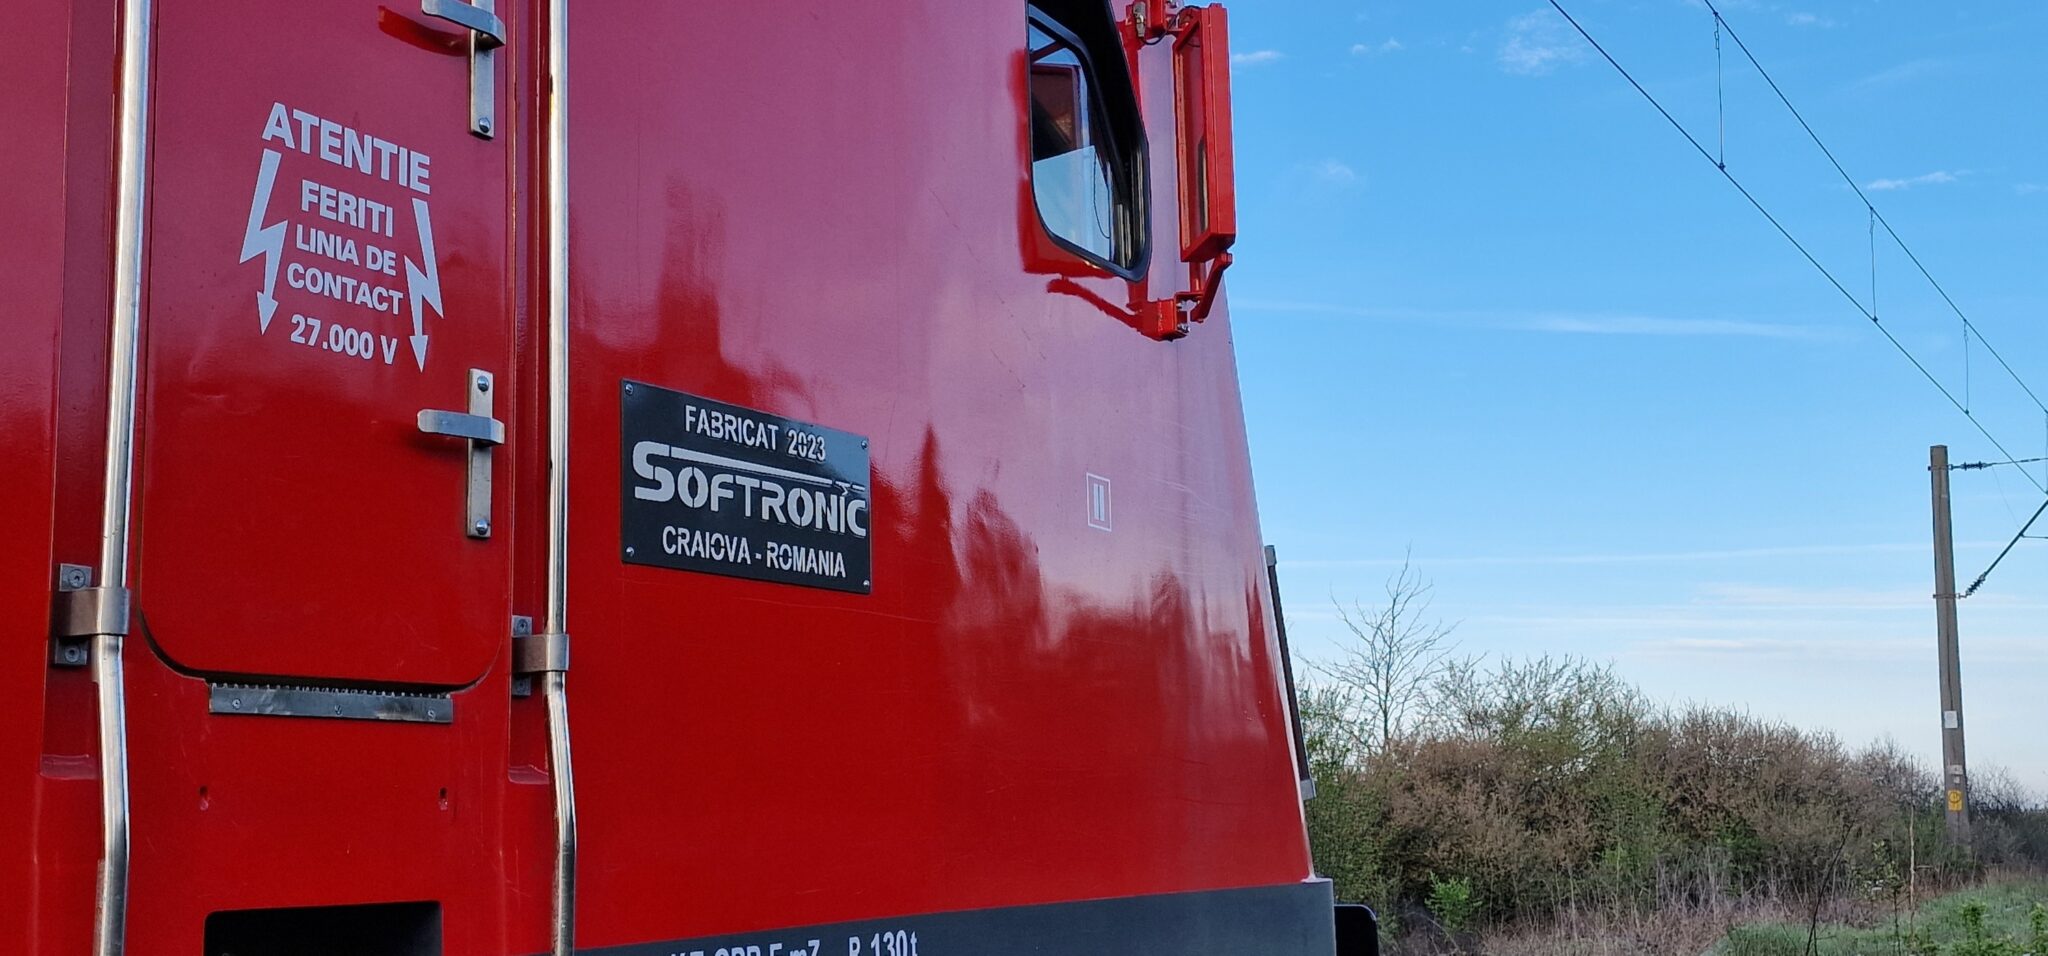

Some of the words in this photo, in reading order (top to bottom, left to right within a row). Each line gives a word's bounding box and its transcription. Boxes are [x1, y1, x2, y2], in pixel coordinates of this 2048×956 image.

[262, 102, 430, 194] ATENTIE
[301, 179, 393, 237] FERITI
[296, 224, 359, 266] LINIA
[366, 245, 397, 276] DE
[287, 263, 403, 315] CONTACT
[290, 314, 374, 360] 27.000
[381, 335, 398, 365] V
[685, 405, 779, 450] FABRICAT
[788, 429, 826, 461] 2023
[633, 440, 867, 537] SOFTRONIC
[663, 525, 751, 565] CRAIOVA
[767, 541, 846, 578] ROMANIA
